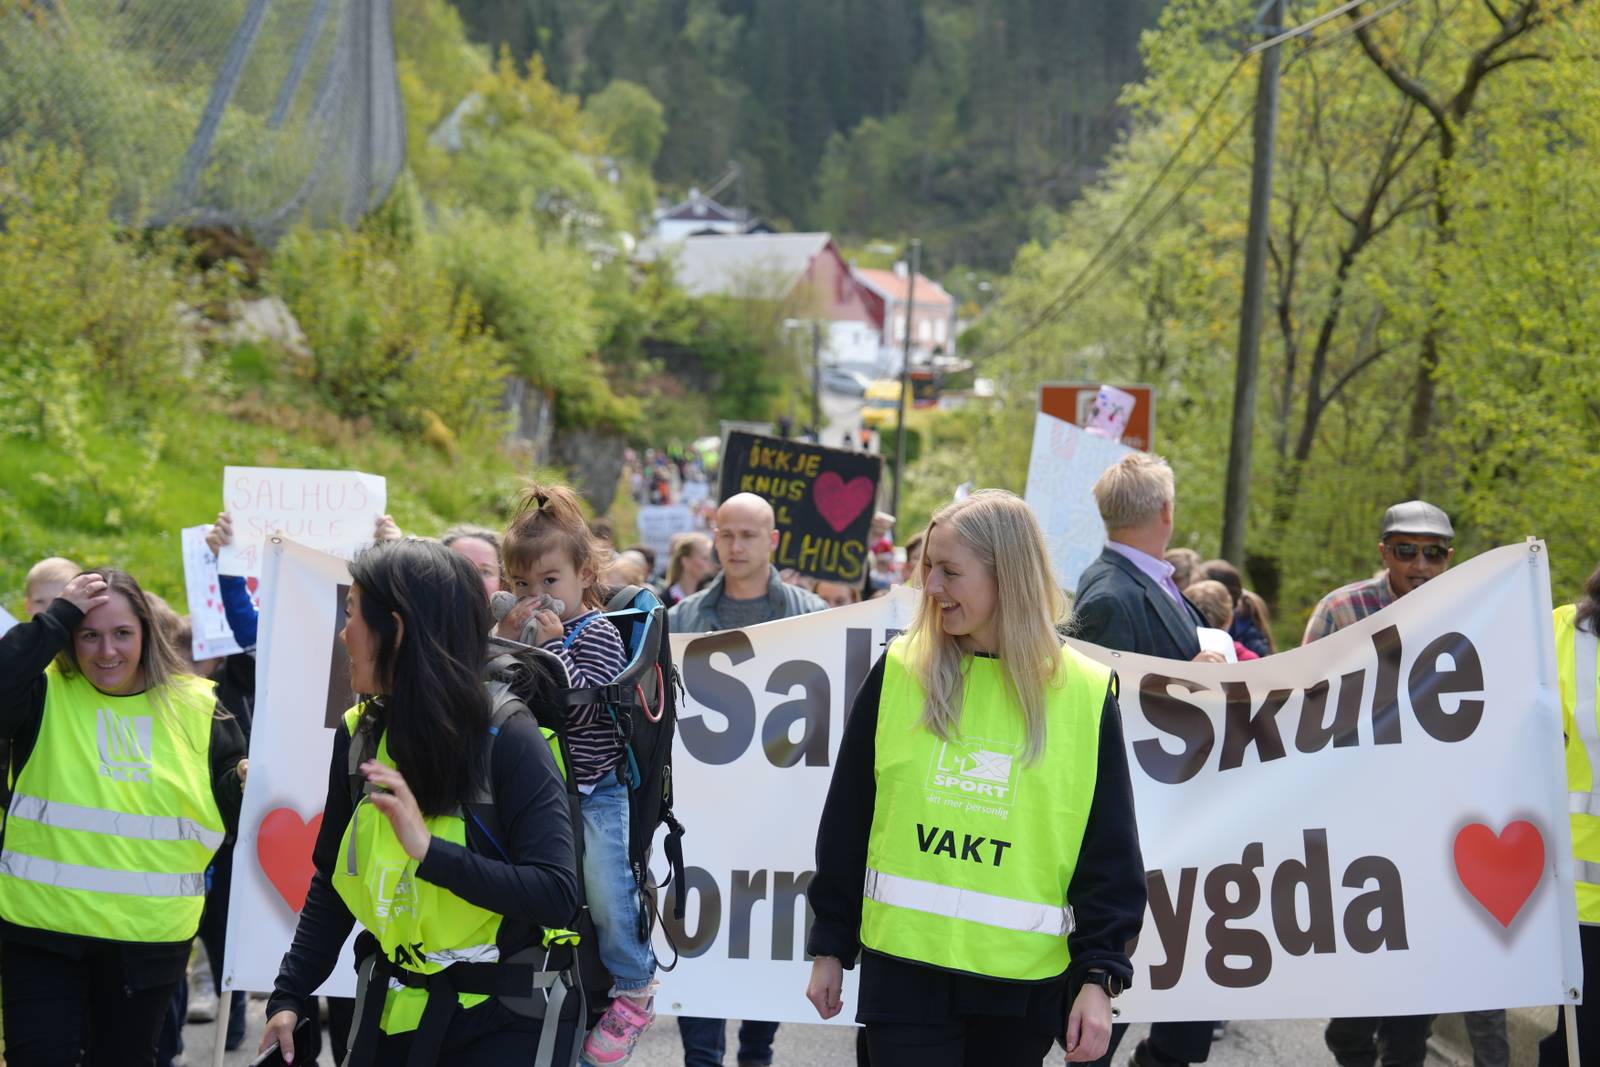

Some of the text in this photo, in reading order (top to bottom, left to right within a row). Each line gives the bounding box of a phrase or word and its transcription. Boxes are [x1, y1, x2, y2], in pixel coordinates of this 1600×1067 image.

[231, 476, 369, 513] SALHUS
[740, 474, 807, 501] KNUS
[247, 518, 344, 539] SKULE
[769, 530, 865, 579] LHUS
[677, 624, 1486, 786] Sal Skule
[933, 773, 1011, 799] SPORT
[916, 823, 1012, 867] VAKT
[1124, 827, 1410, 990] ygda
